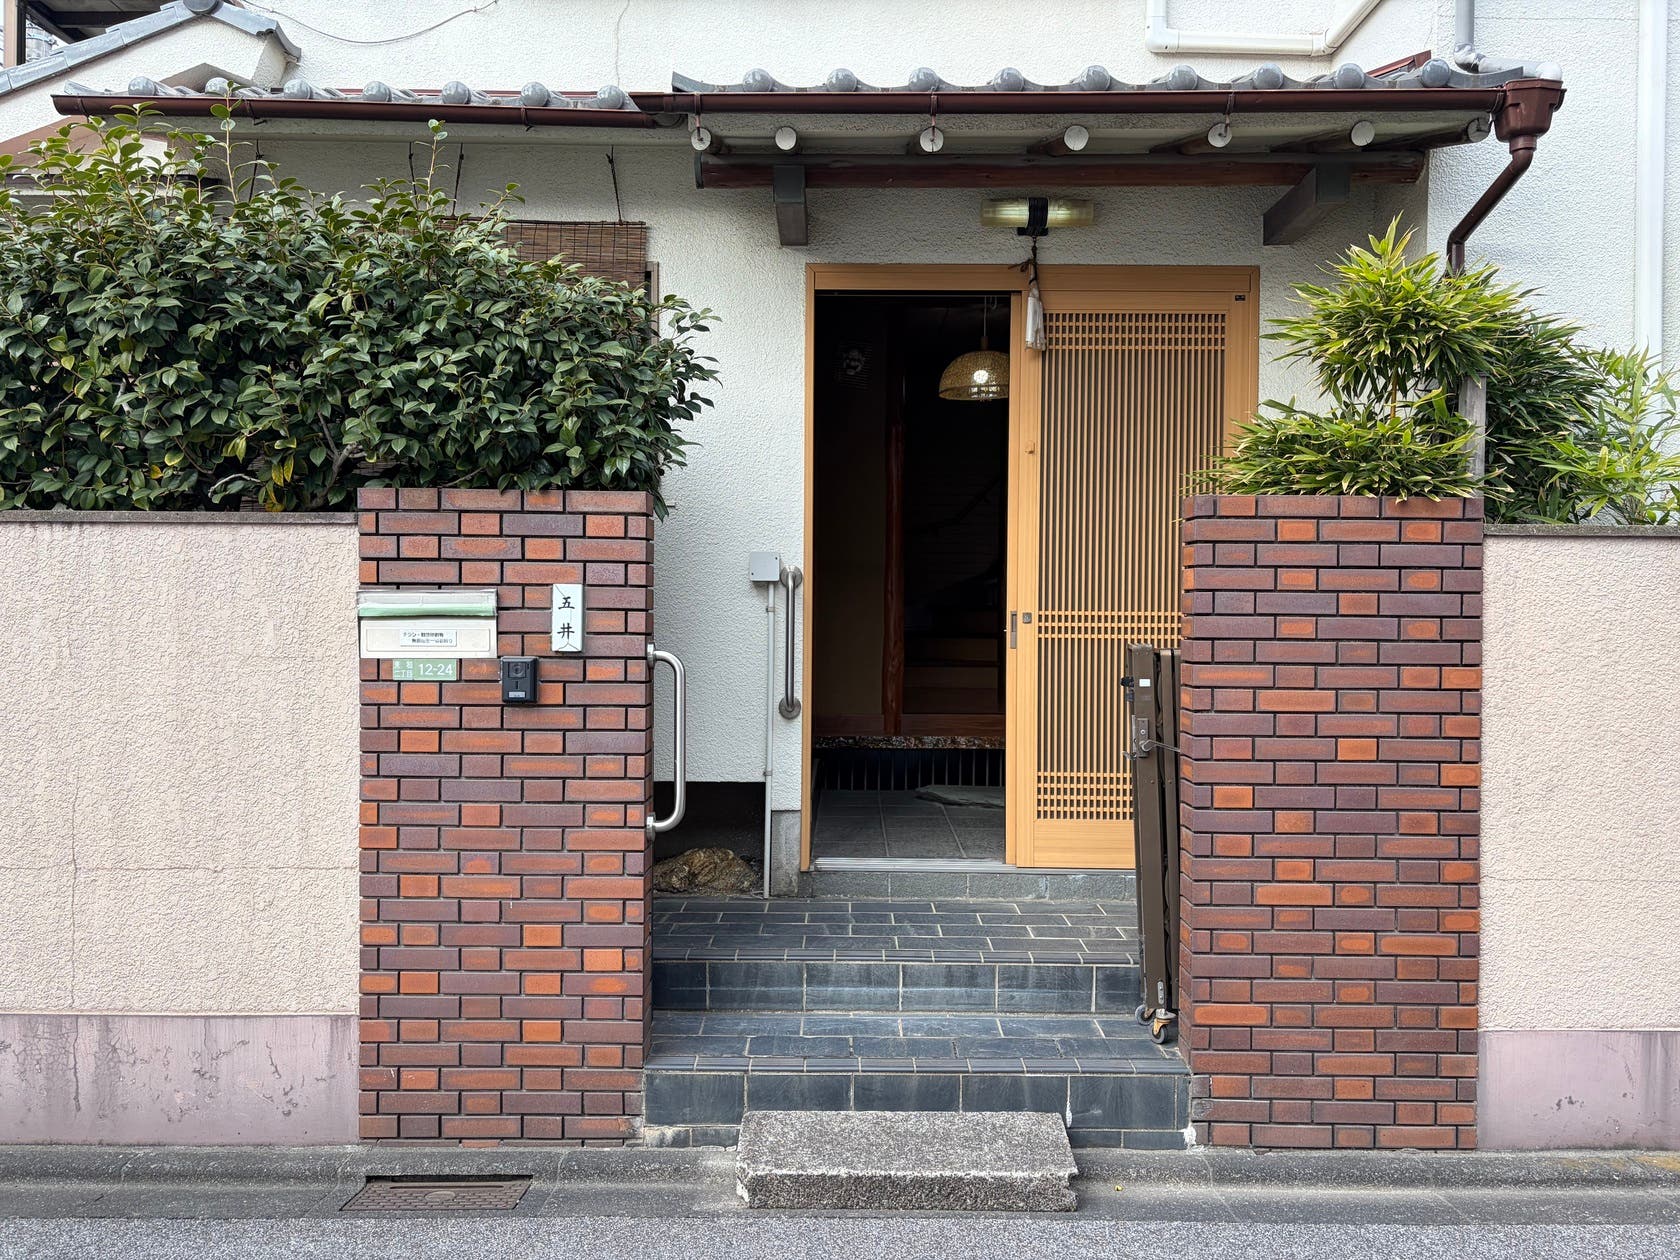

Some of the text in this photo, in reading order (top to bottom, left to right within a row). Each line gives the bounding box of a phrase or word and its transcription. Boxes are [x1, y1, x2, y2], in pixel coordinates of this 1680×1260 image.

[556, 596, 575, 639] 五井
[394, 669, 412, 678] 二丁目
[418, 663, 453, 676] 12-24
